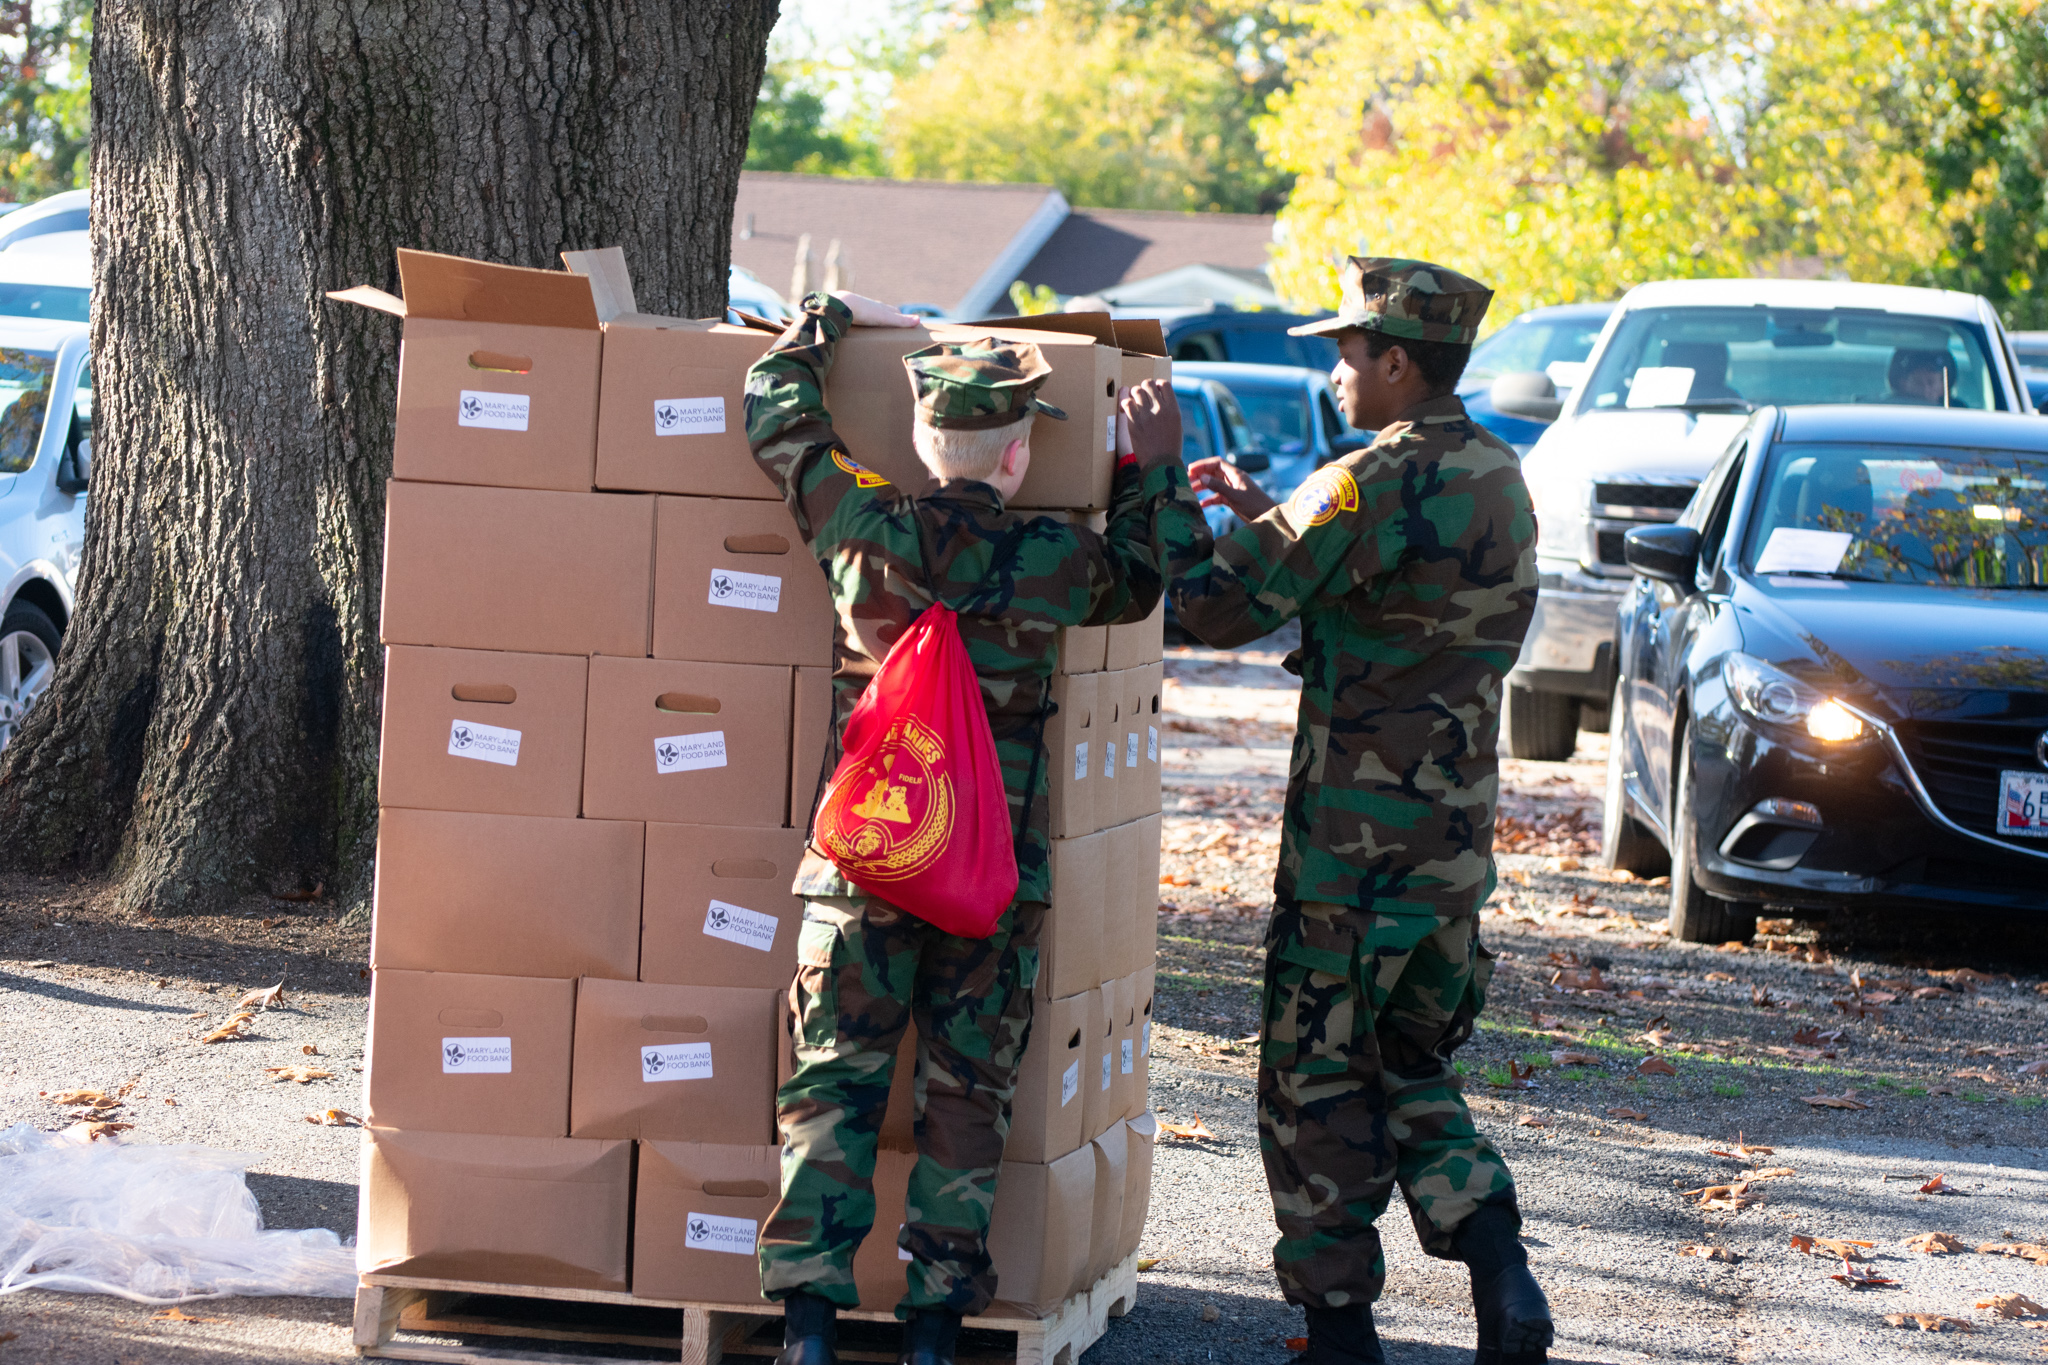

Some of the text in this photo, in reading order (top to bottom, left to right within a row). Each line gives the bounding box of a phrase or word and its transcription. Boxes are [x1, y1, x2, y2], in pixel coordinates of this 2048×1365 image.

[484, 402, 528, 412] MARYLAND
[679, 406, 724, 415] MARYLAND
[483, 410, 527, 420] FOOD BANK
[680, 415, 724, 424] FOOD BANK
[735, 581, 780, 594] MARYLAND
[734, 589, 778, 602] FOOD BANK
[475, 733, 519, 747] MARYLAND
[680, 740, 724, 752] MARYLAND
[901, 722, 941, 764] ARINES
[474, 741, 517, 755] FOOD BANK
[681, 749, 725, 760] FOOD BANK
[731, 915, 776, 933] MARYLAND
[729, 923, 773, 941] FOOD BANK
[666, 1052, 711, 1061] MARYLAND
[667, 1060, 711, 1069] FOOD BANK
[711, 1225, 756, 1236] MARYLAND
[710, 1232, 755, 1244] FOOD BANK
